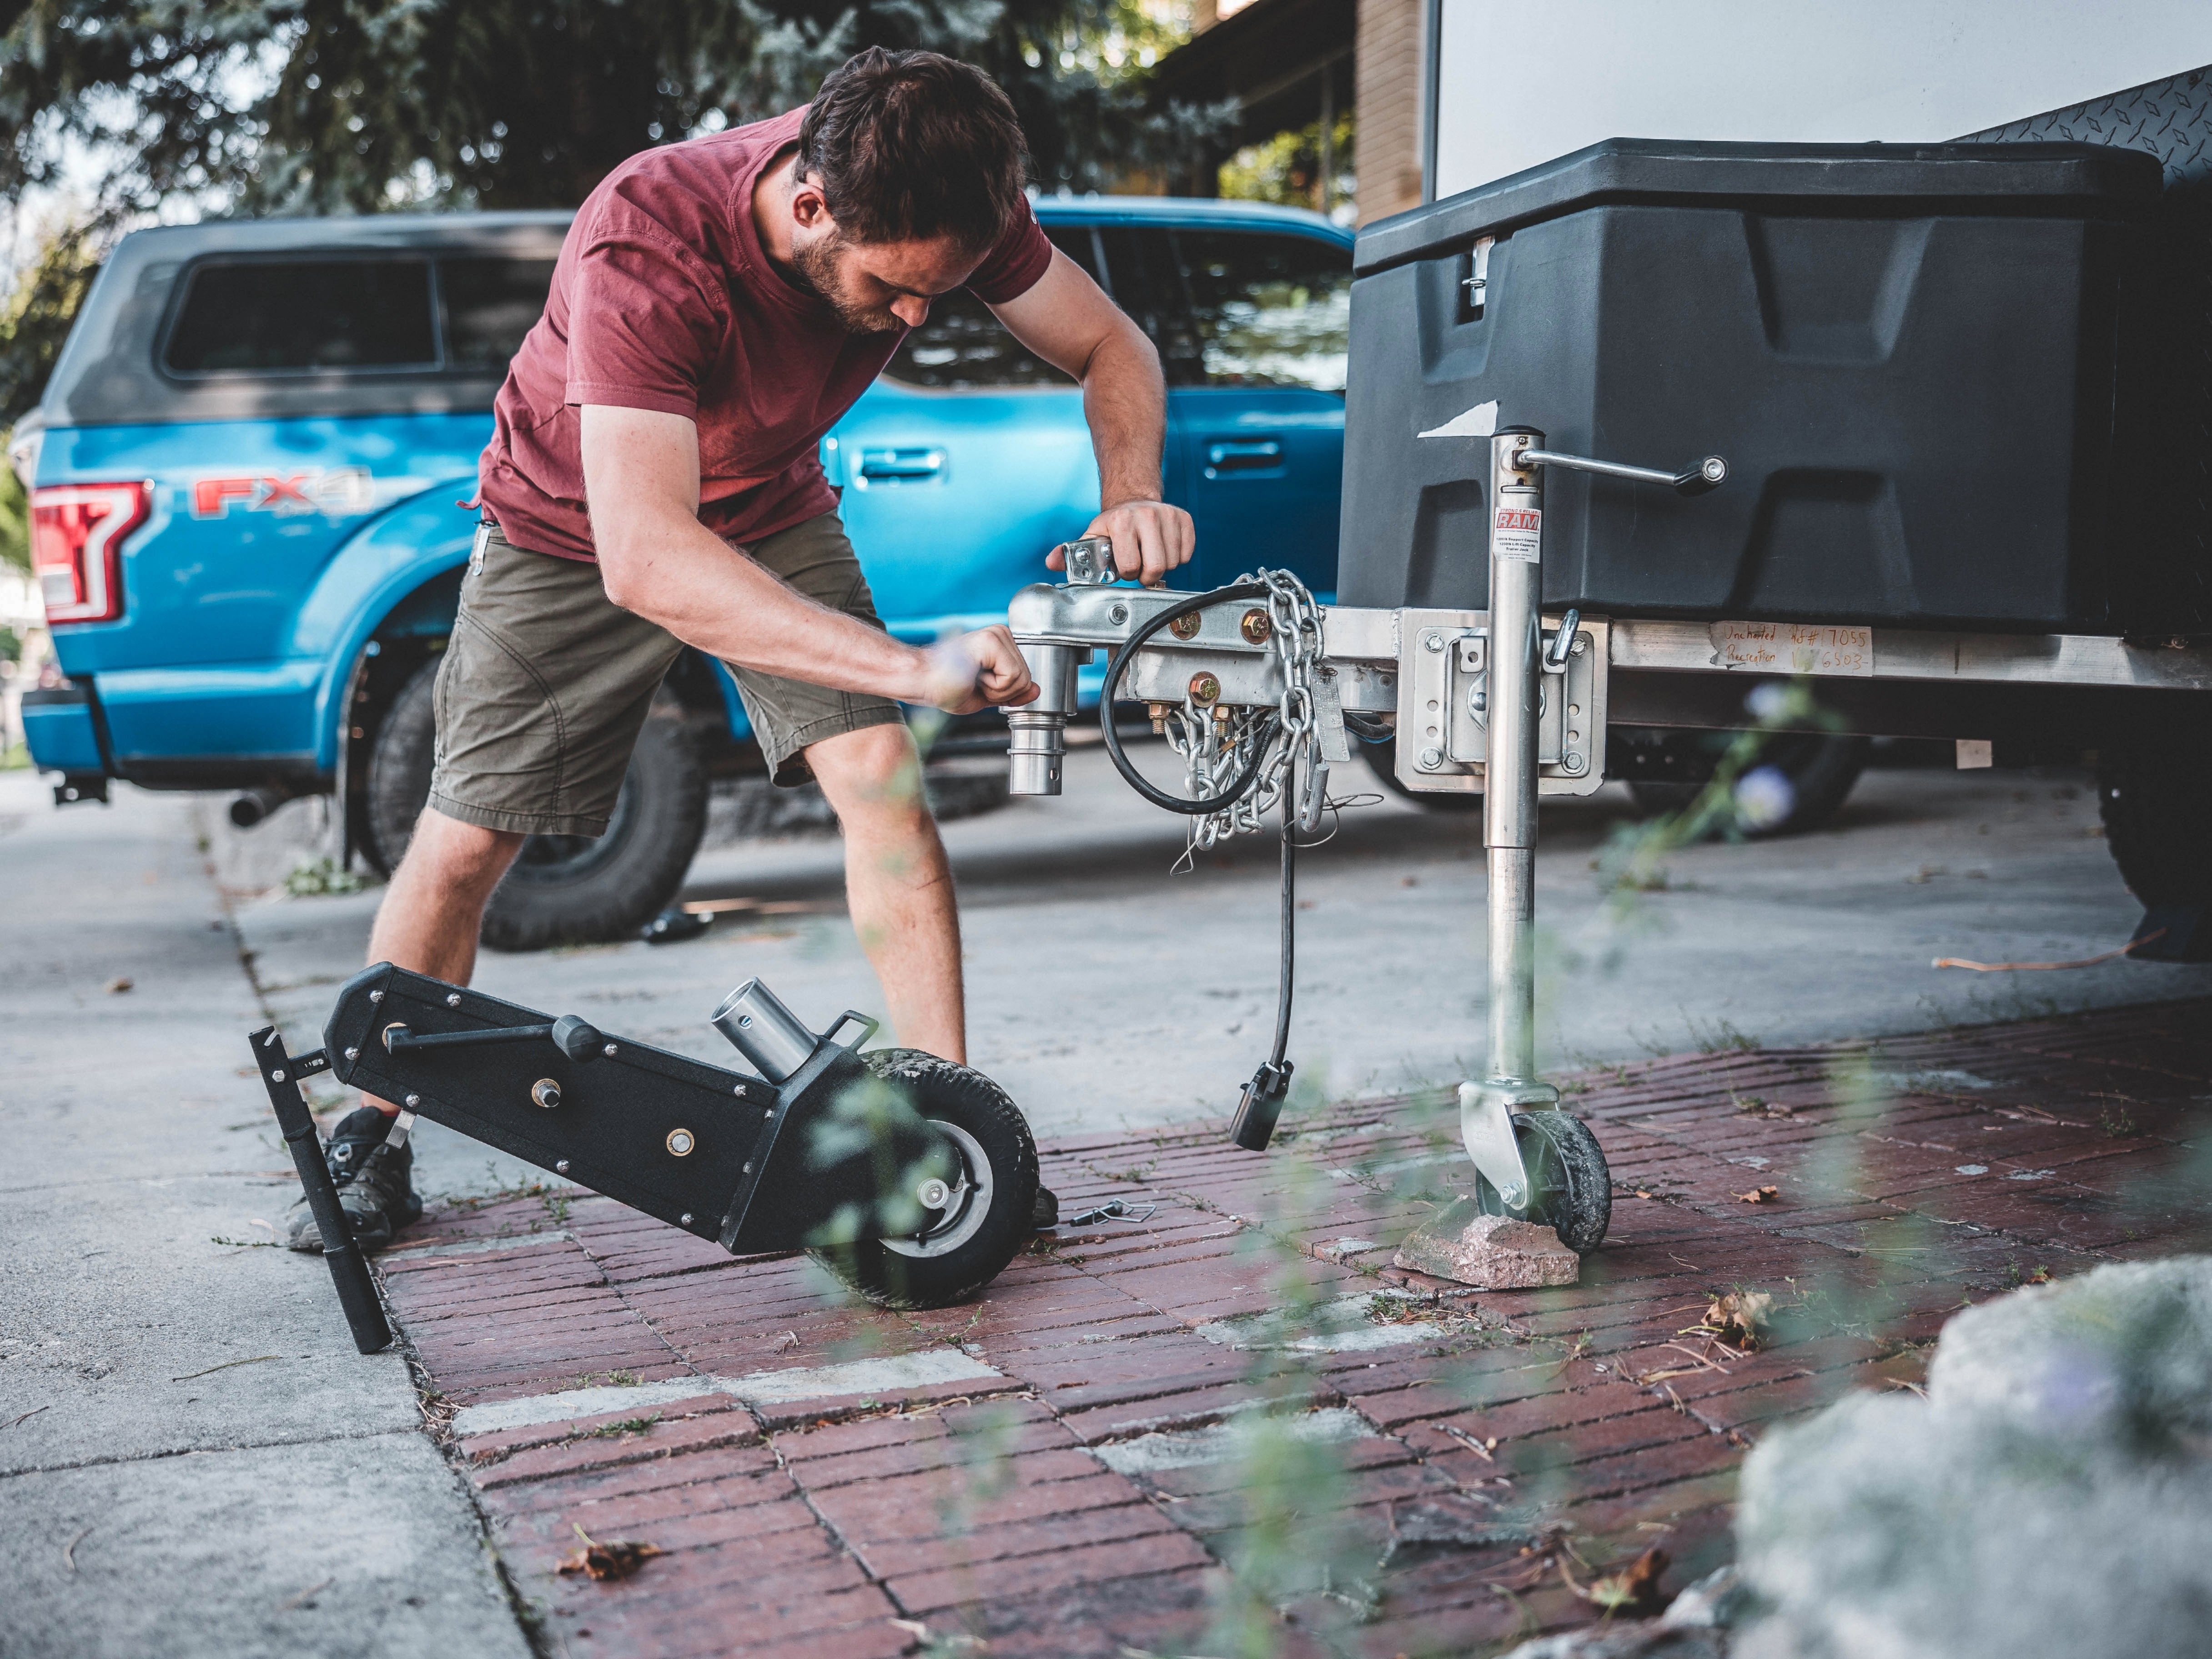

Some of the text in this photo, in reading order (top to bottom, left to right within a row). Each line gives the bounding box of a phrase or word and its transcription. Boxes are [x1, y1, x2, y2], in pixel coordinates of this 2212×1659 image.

[1497, 513, 1538, 530] RAM
[1724, 624, 1775, 641] Uncharted
[1725, 643, 1775, 663] Recreation
